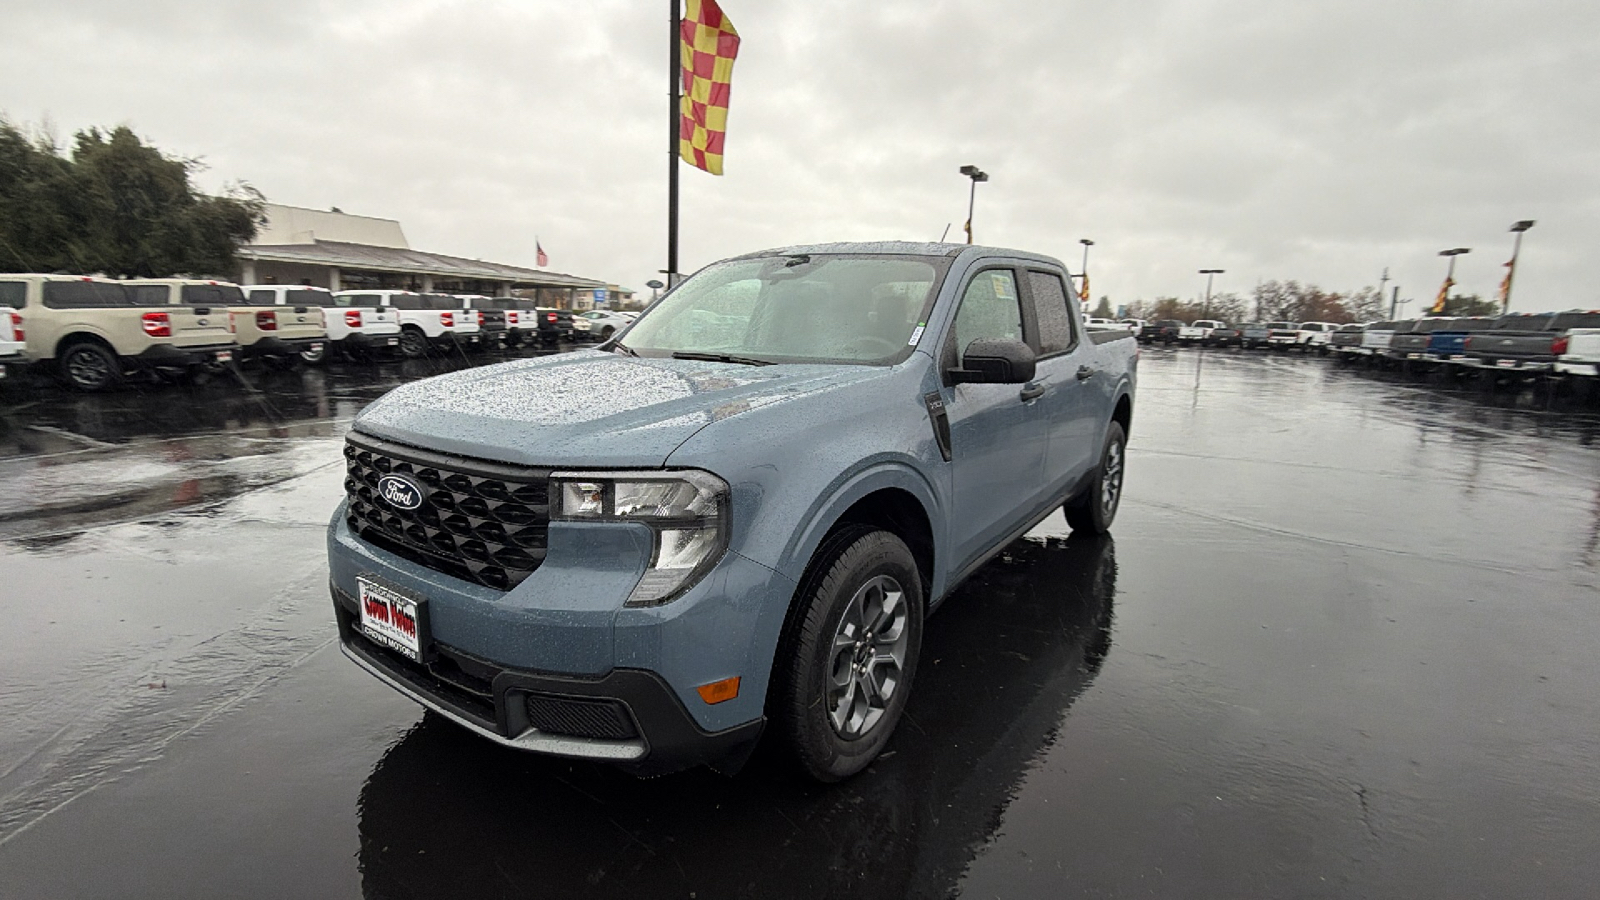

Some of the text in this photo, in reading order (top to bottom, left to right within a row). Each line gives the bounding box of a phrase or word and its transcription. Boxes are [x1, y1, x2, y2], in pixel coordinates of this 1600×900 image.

[385, 479, 413, 506] Ford
[364, 626, 388, 644] CROWN
[388, 637, 416, 660] MOTORS
